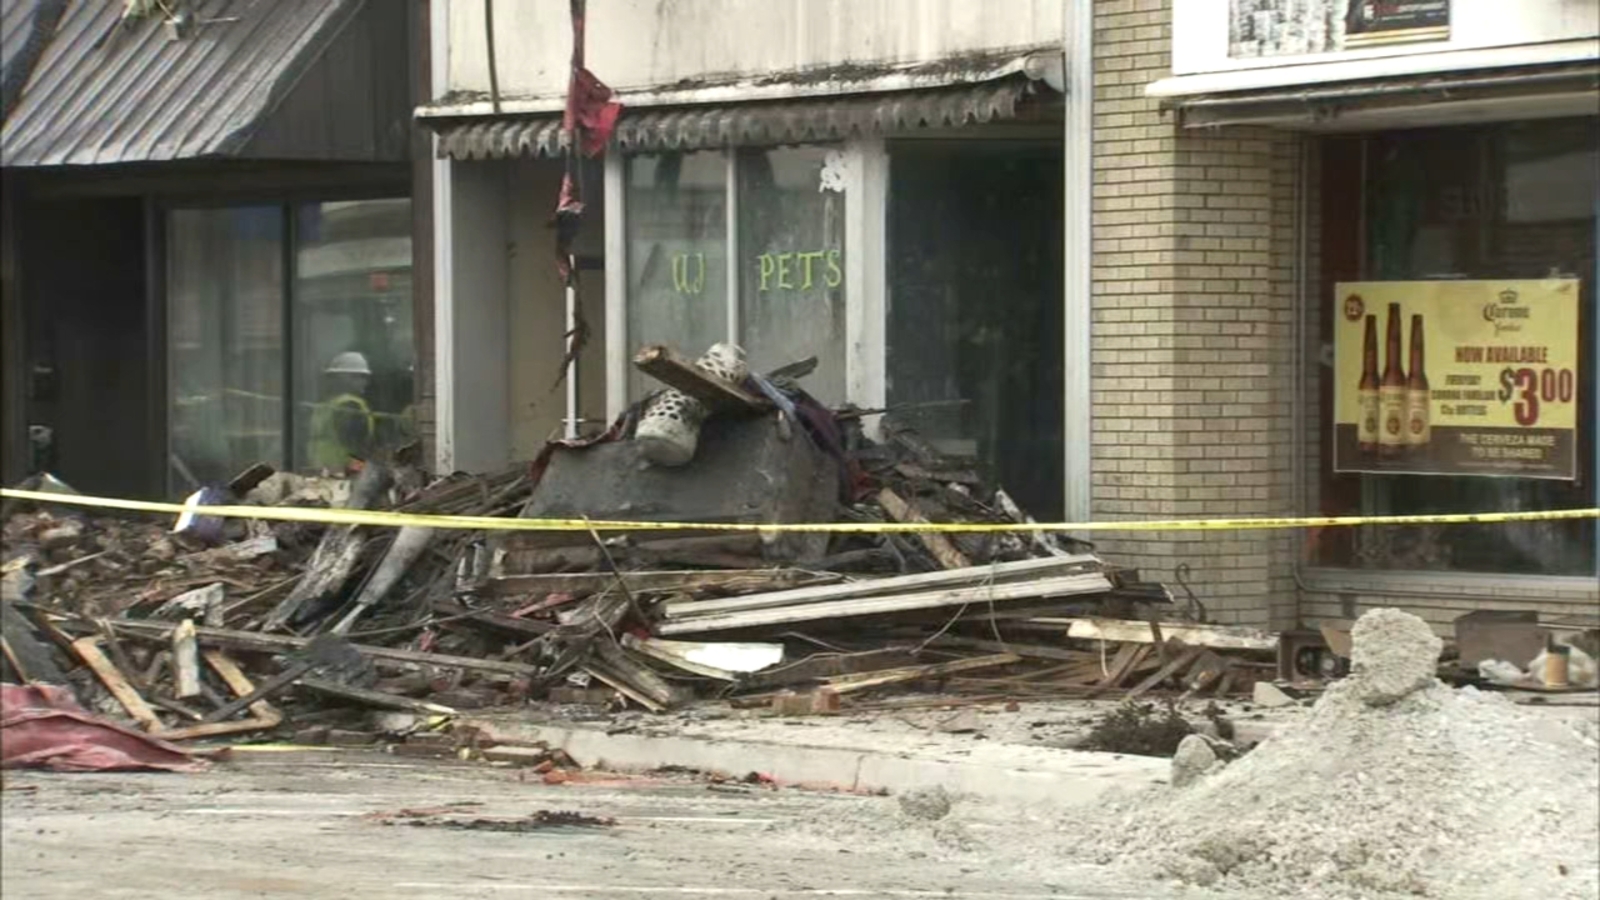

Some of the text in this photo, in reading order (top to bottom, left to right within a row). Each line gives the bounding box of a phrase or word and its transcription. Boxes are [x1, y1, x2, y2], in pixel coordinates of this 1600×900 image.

[757, 250, 842, 291] PETS
[1455, 346, 1549, 364] NOW AVAILABLE
[1460, 433, 1555, 447] THE CERVEZA MADE
[1471, 446, 1486, 458] TO
[1502, 447, 1543, 459] SHARED
